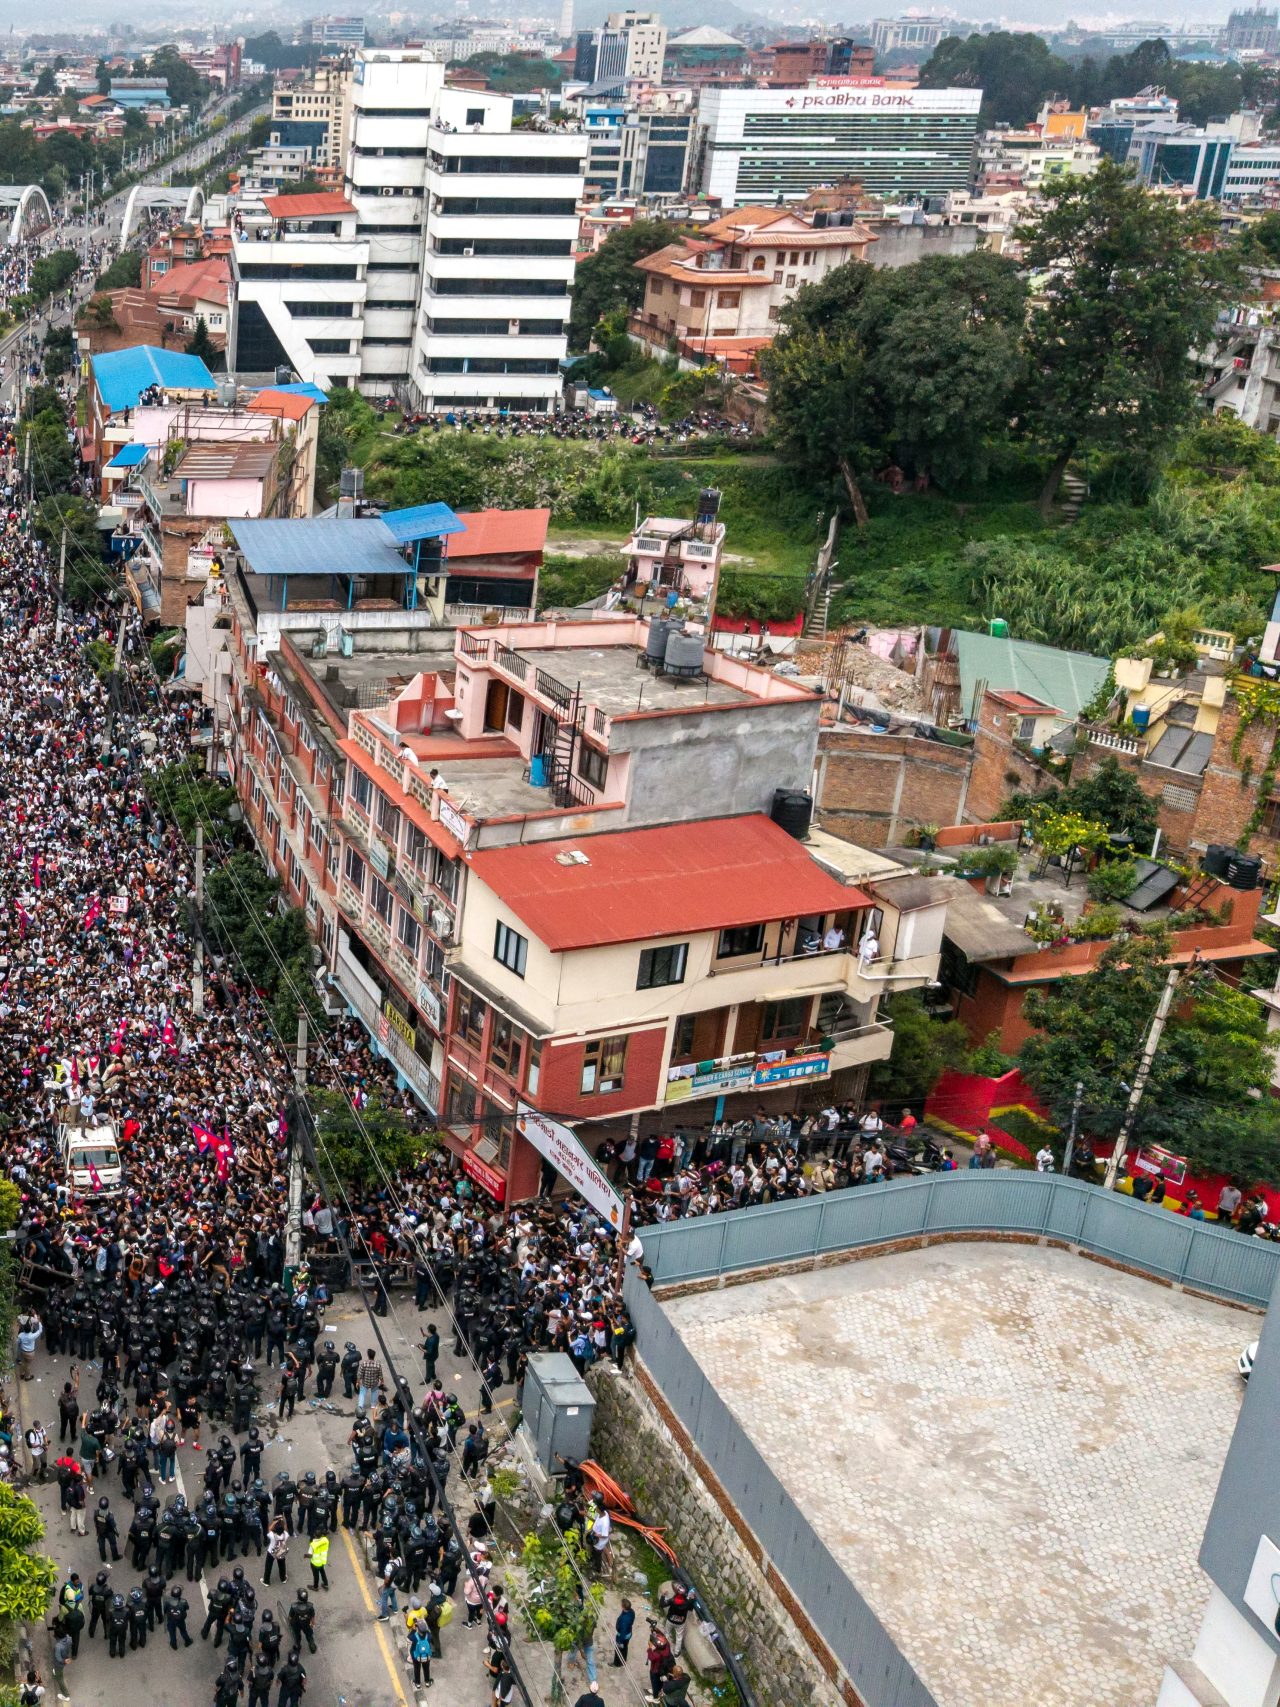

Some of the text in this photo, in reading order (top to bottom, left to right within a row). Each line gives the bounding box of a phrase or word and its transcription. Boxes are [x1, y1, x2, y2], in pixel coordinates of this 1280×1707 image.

[694, 1073, 713, 1085] COURIER
[719, 1069, 733, 1080] CARGO
[734, 1067, 753, 1077] SERVICE
